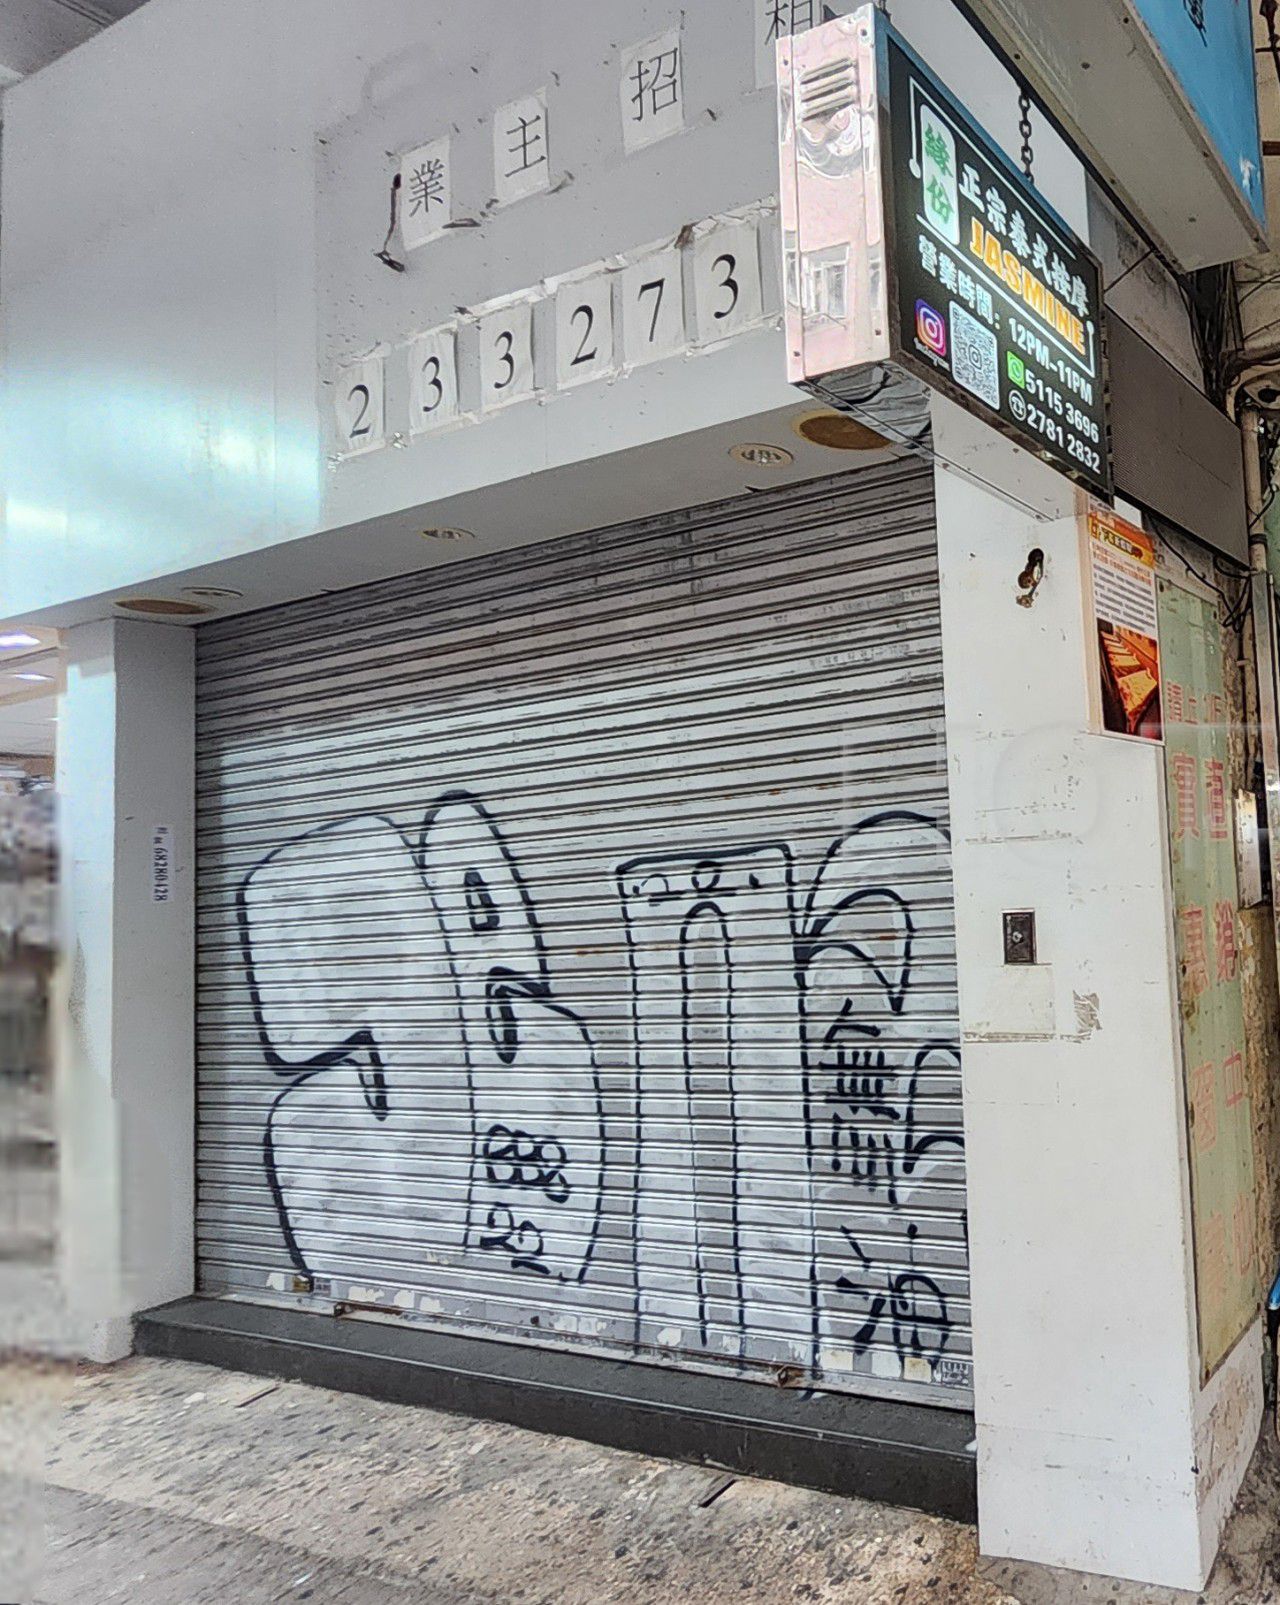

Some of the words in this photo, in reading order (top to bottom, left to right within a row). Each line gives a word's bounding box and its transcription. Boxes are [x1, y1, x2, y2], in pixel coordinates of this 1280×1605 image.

[958, 163, 1090, 317] 正宗泰式按摩
[969, 215, 1086, 356] JASMINE
[1008, 317, 1093, 407] 12PM-11PM
[1025, 368, 1063, 416] 5115
[1065, 402, 1099, 444] 3696
[1027, 403, 1064, 449] 2781
[1067, 433, 1100, 475] 2832
